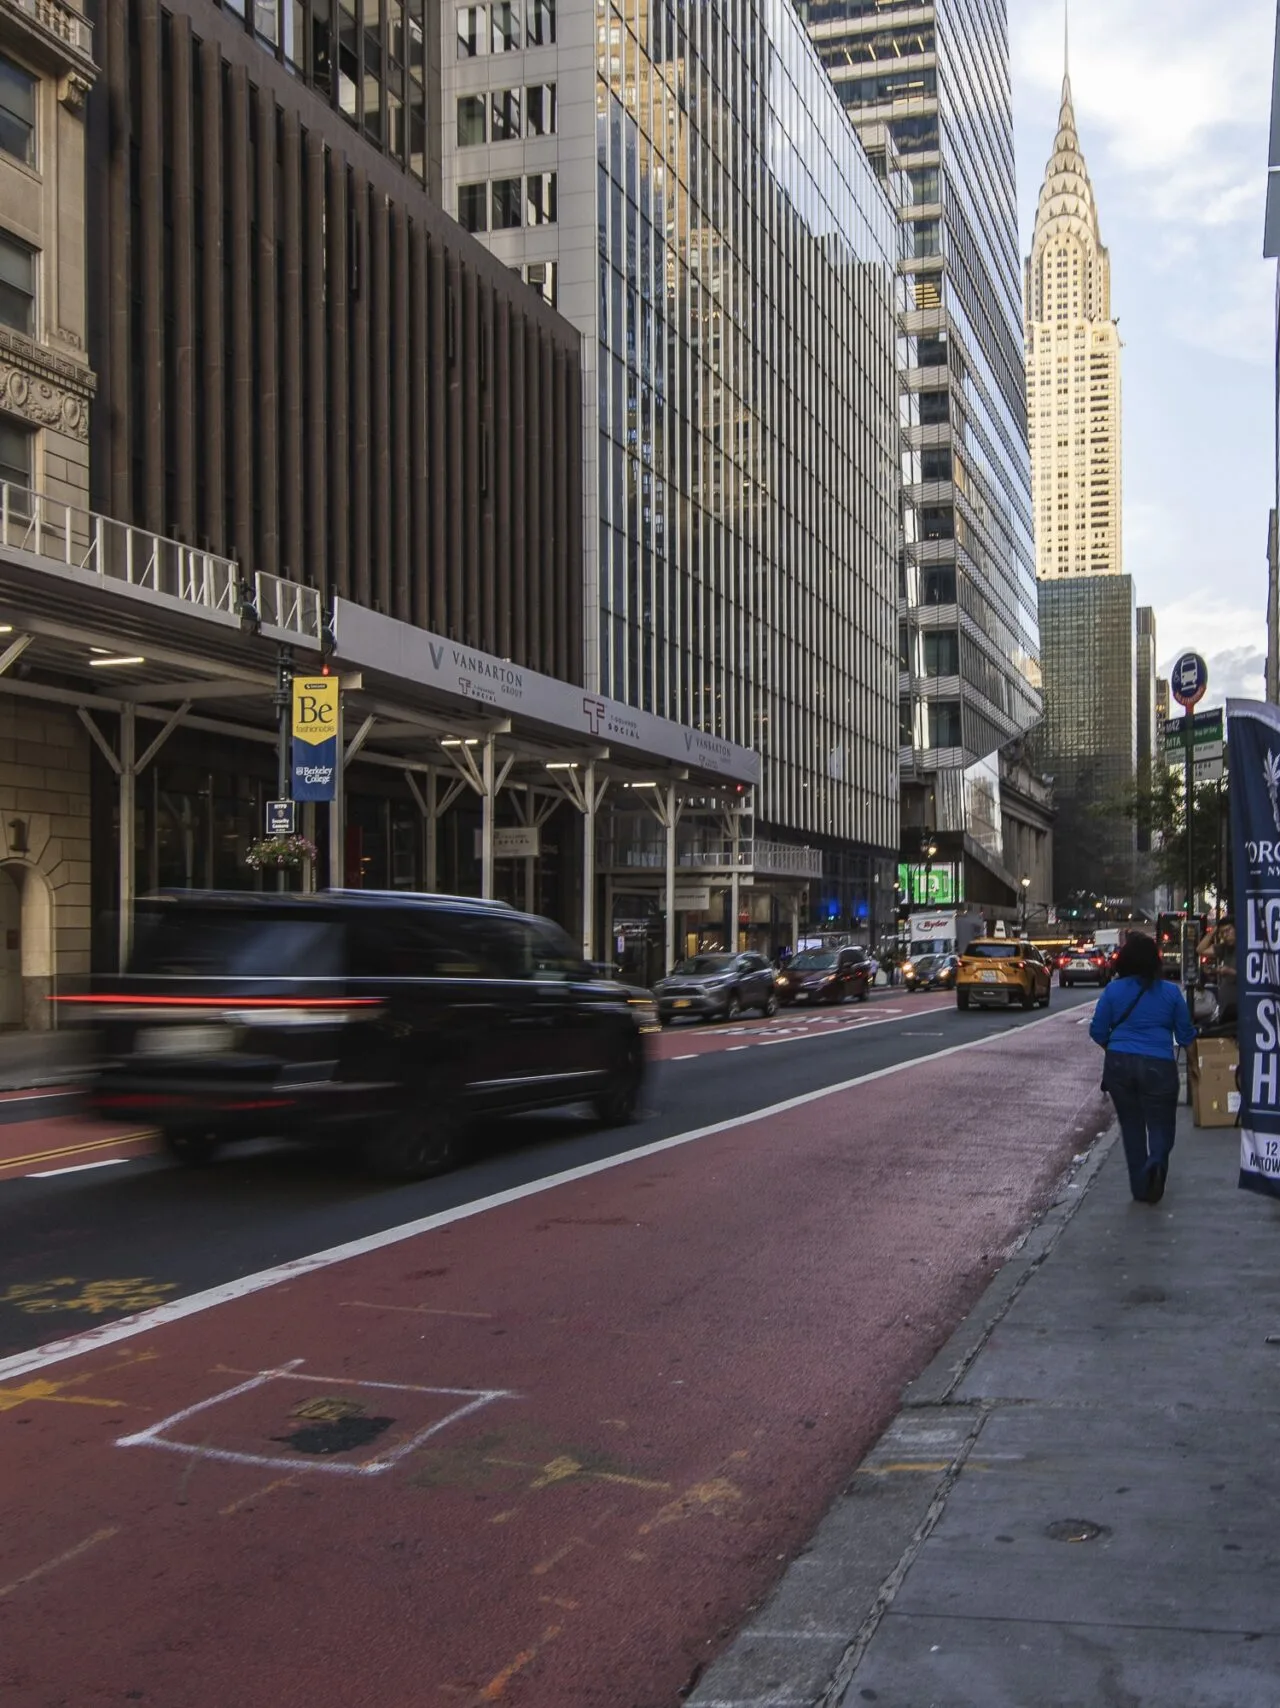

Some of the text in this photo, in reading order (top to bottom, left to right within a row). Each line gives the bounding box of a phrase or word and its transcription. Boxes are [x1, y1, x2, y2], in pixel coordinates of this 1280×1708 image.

[452, 650, 523, 688] VANBARTON
[298, 695, 333, 724] Be
[608, 722, 640, 740] SOCIAL
[303, 765, 333, 777] Berkeley
[305, 774, 331, 785] College
[923, 919, 949, 930] Ryder
[1266, 1141, 1278, 1156] 12
